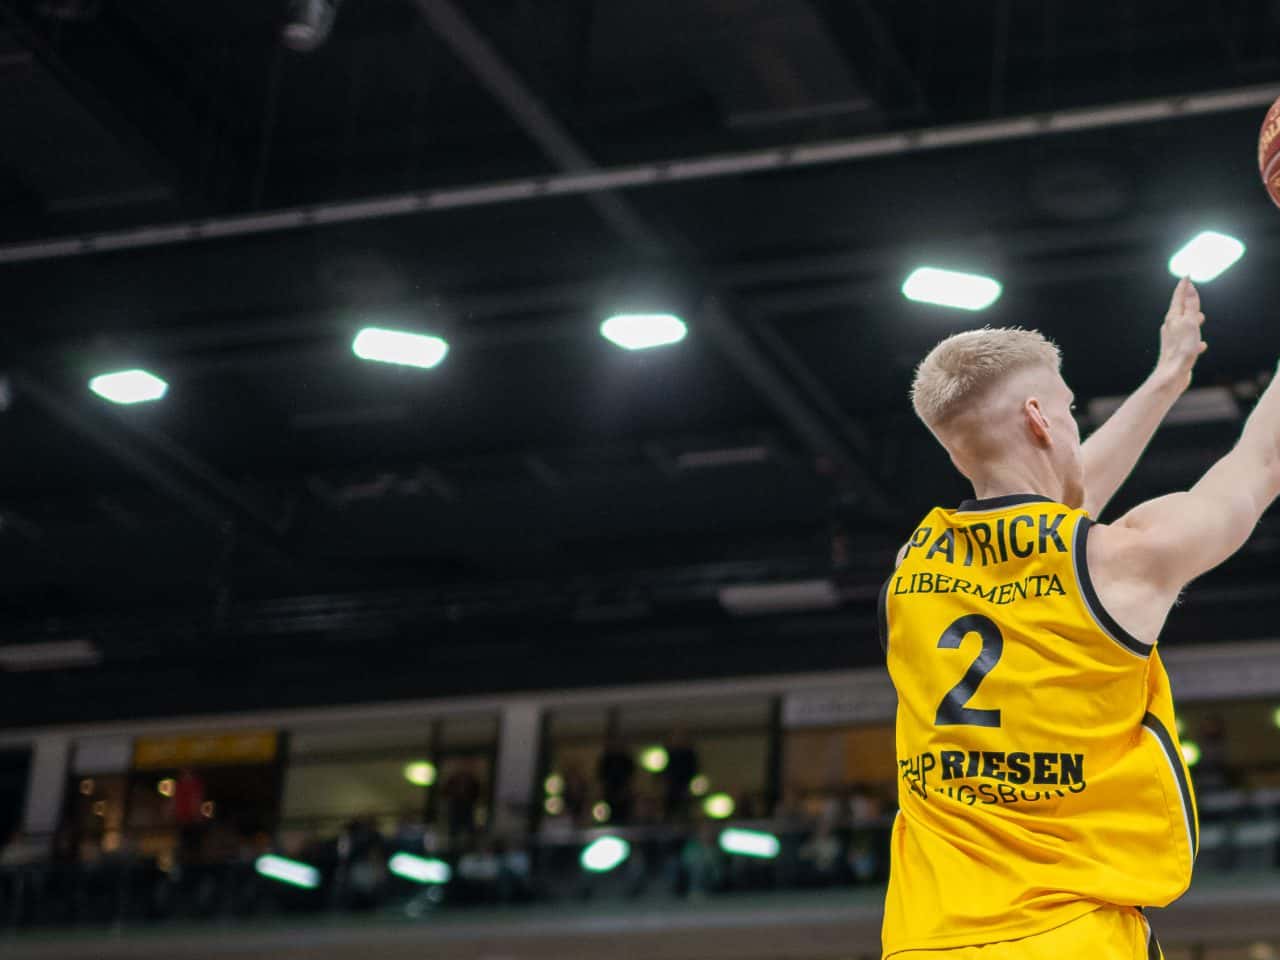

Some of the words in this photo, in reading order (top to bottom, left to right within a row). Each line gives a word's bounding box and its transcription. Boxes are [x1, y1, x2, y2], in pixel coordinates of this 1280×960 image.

[893, 572, 1067, 605] LIBERMENTA
[934, 613, 1004, 728] 2
[940, 750, 1085, 786] RIESEN
